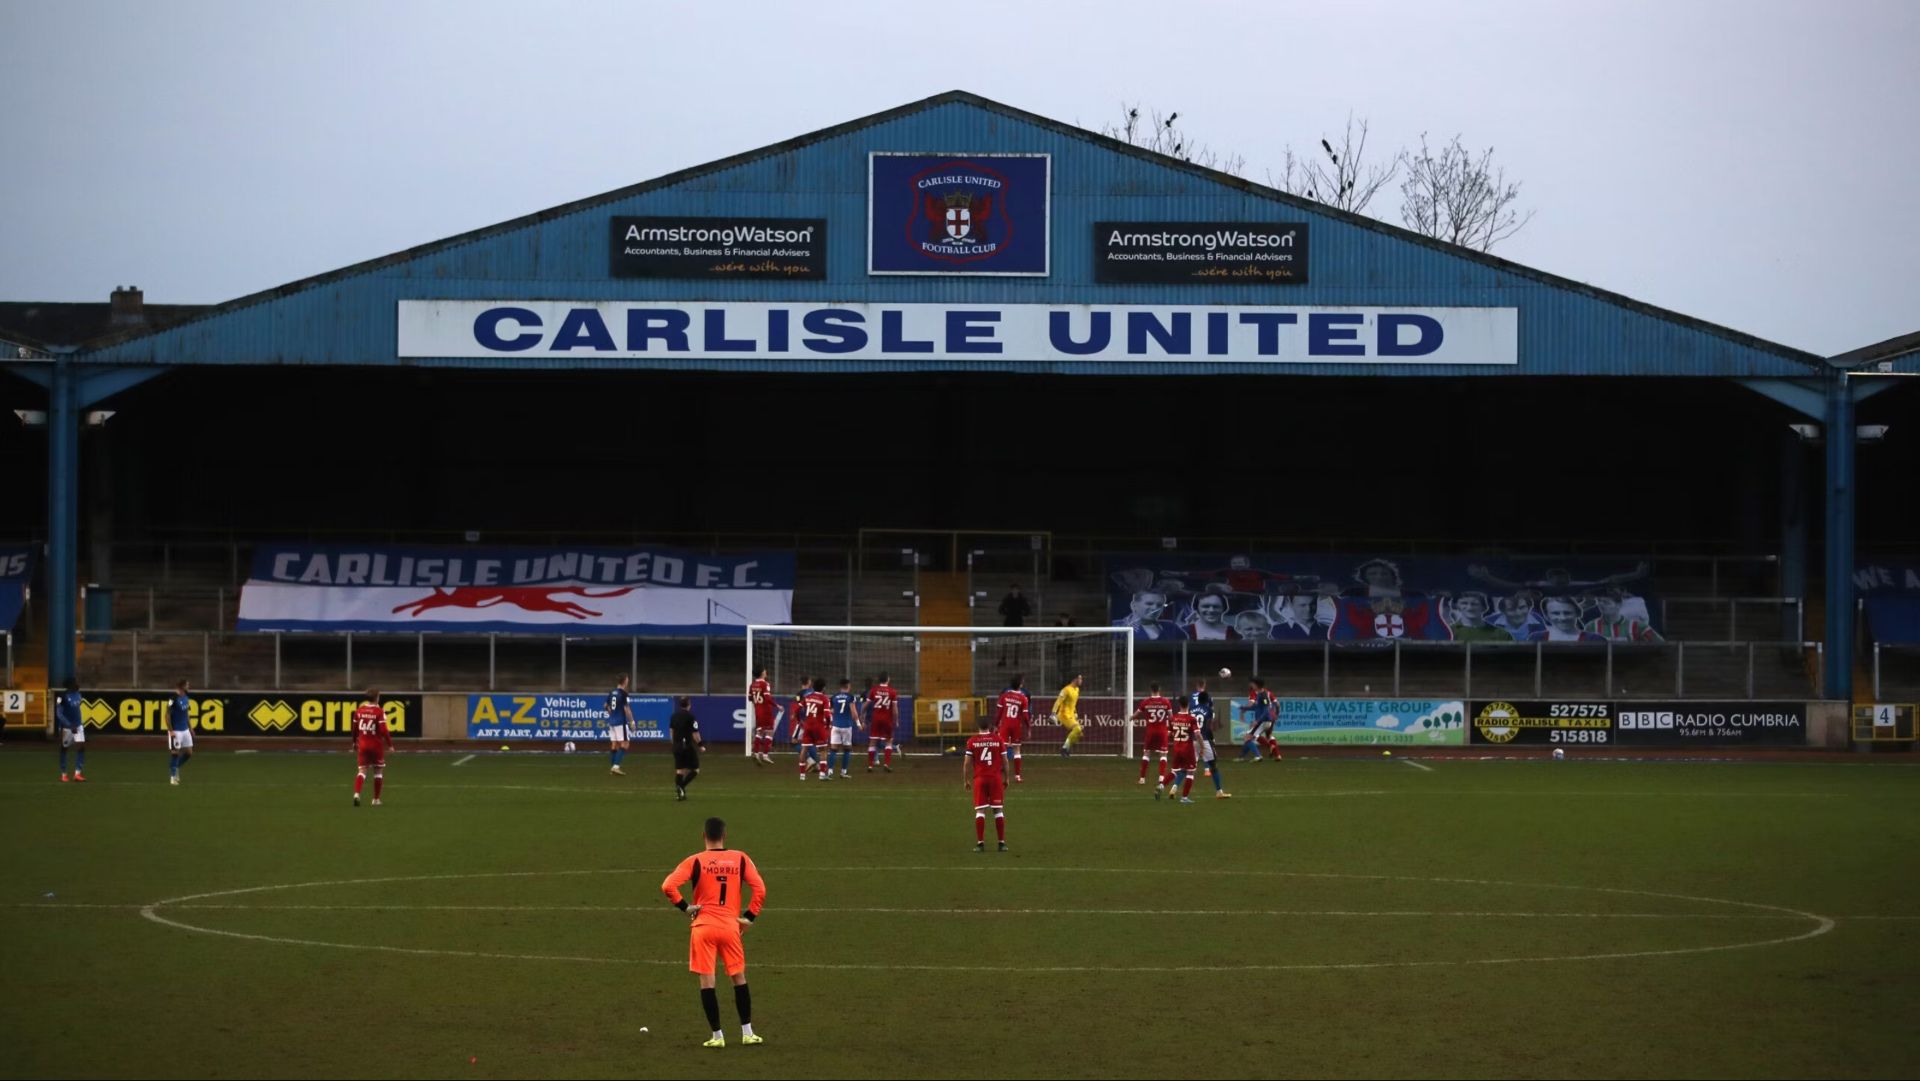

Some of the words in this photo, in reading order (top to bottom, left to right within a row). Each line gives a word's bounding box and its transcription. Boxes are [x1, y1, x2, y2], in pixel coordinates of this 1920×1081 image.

[918, 175, 962, 189] CARLISLE
[965, 175, 1001, 189] UNITED
[624, 247, 682, 257] Accountants,
[684, 248, 722, 257] Business
[724, 249, 731, 257] &
[733, 248, 770, 257] Financial
[772, 249, 810, 257] Advisers
[922, 242, 970, 254] FOOTBALL
[972, 242, 996, 254] CLUB
[1108, 252, 1164, 262] Accountants,
[1166, 252, 1205, 262] Business
[1207, 253, 1213, 262] &
[1216, 253, 1253, 262] Financial
[1255, 253, 1293, 262] Advisers
[749, 260, 780, 272] with
[783, 264, 811, 276] you
[1232, 264, 1262, 277] with
[1266, 267, 1293, 280] you
[473, 307, 1002, 355] CARLISLE
[1048, 310, 1444, 357] UNITED
[272, 553, 503, 587] CARLISLE
[512, 552, 684, 584] UNITED
[695, 561, 773, 588] F.C.
[1852, 565, 1896, 590] WE
[10, 693, 19, 710] 2
[544, 697, 587, 709] Vehicle
[611, 696, 618, 710] 8
[837, 699, 847, 714] 7
[873, 695, 891, 710] 24
[1324, 702, 1373, 713] WASTE
[1378, 702, 1432, 713] GROUP
[472, 696, 537, 724] A-Z
[541, 707, 610, 719] Dismantlers
[806, 702, 818, 718] 14
[1005, 702, 1018, 718] 10
[1147, 709, 1166, 723] 39
[1483, 702, 1516, 716] 527575
[1550, 704, 1607, 717] 527575
[1880, 707, 1889, 724] 4
[358, 718, 377, 735] 44
[541, 719, 593, 728] 01228
[1336, 720, 1366, 728] Cumbria
[1476, 718, 1509, 727] RADIO
[1511, 718, 1560, 727] CARLISLE
[1568, 718, 1607, 727] TAXIS
[1620, 712, 1673, 728] BBC
[1675, 714, 1726, 727] RADIO
[1730, 714, 1800, 727] CUMBRIA
[477, 729, 502, 737] ANY
[503, 729, 533, 739] PART,
[535, 729, 559, 737] ANY
[561, 729, 597, 740] MAKE,
[1172, 725, 1189, 742] 25
[1549, 730, 1607, 743] 515818
[1679, 728, 1706, 737] 95.6FM
[1716, 728, 1742, 737] 756AM
[980, 747, 992, 766] 4
[706, 866, 738, 874] MORRIS
[716, 876, 727, 905] 1
